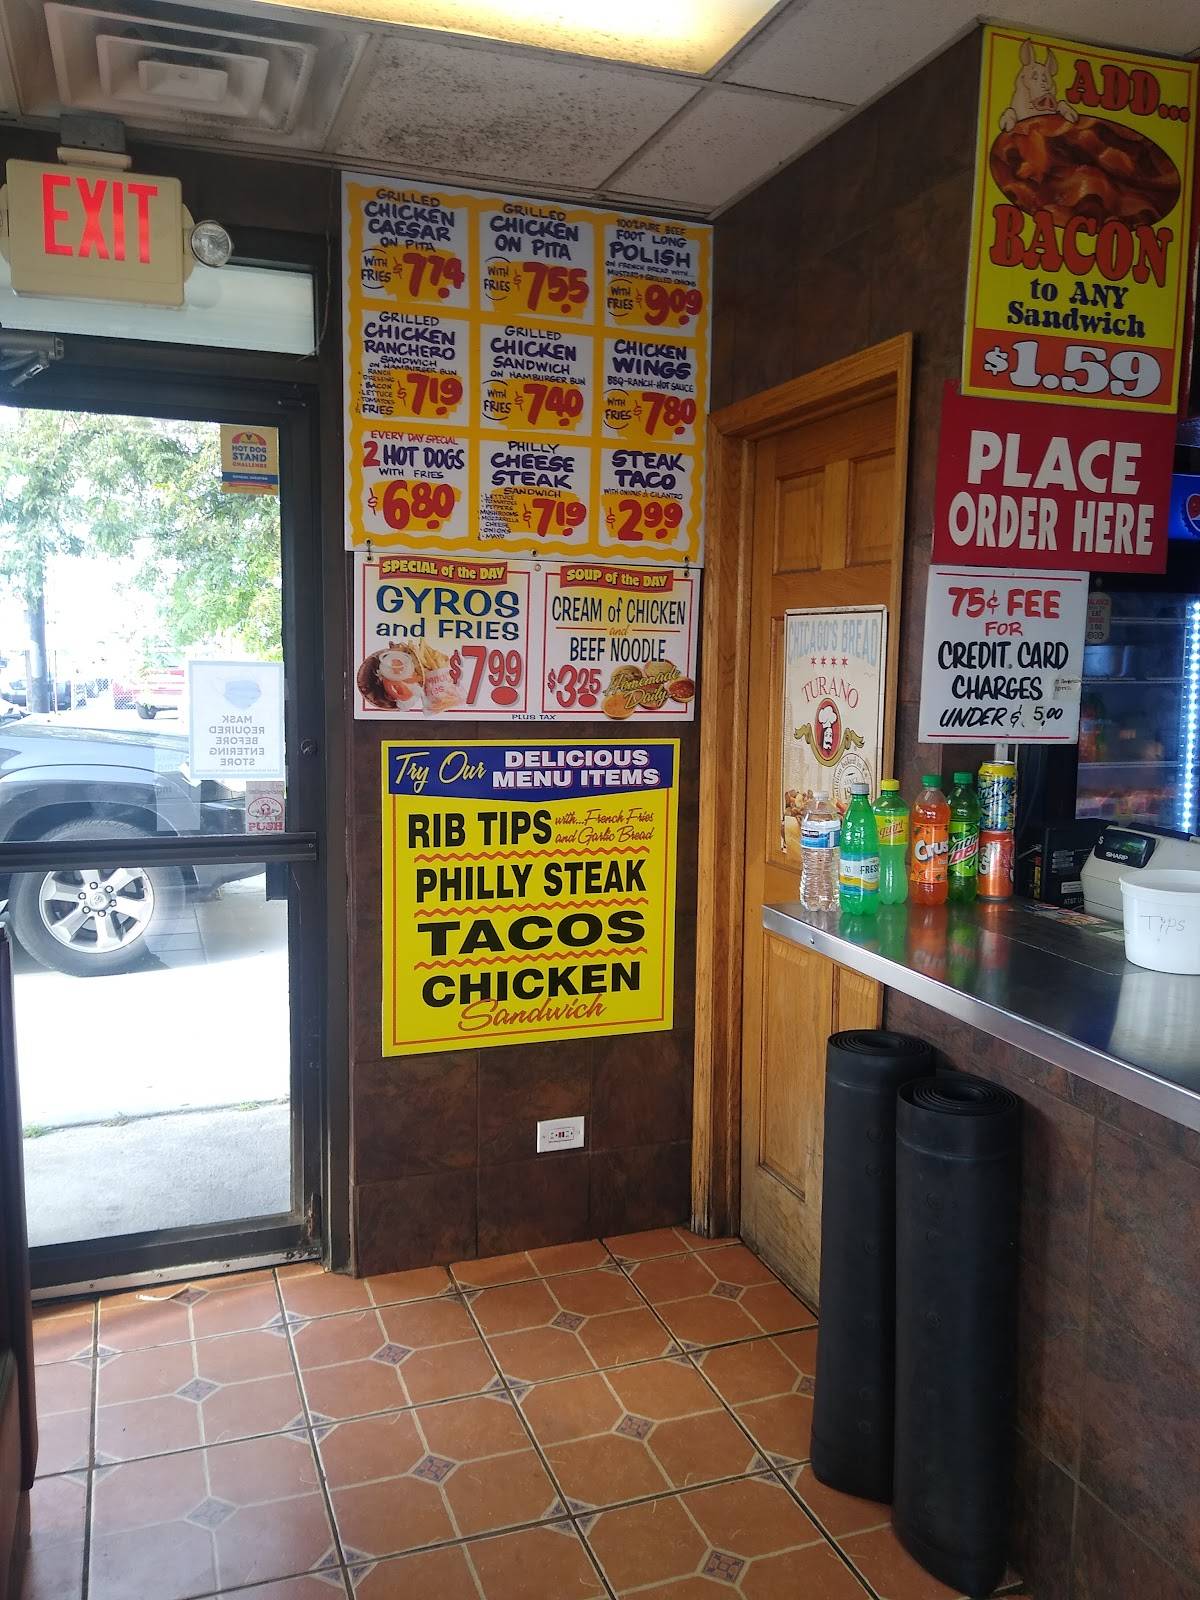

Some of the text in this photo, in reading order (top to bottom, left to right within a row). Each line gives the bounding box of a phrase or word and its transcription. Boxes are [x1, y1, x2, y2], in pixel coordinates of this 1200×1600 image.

[376, 189, 440, 207] GRILLED
[43, 173, 158, 264] EXIT
[365, 201, 454, 227] CHICKEN
[503, 204, 566, 221] GRILLED
[368, 219, 451, 241] CAESAR
[490, 216, 578, 241] CHICKEN
[616, 230, 687, 248] FOOT LONG
[380, 237, 436, 252] ON PITA
[495, 235, 571, 260] ON PITA
[609, 241, 690, 268] POLISH
[990, 204, 1173, 287] BACON
[364, 256, 388, 267] WITH
[488, 266, 509, 277] WITH
[362, 269, 391, 282] FRIES
[484, 279, 510, 292] FRIES
[607, 298, 633, 310] FRIES
[1031, 278, 1128, 309] to ANY
[379, 311, 440, 326] GRILLED
[1008, 301, 1145, 337] Sandwich
[364, 322, 455, 346] CHICKEN
[505, 325, 561, 341] GRILLED
[364, 340, 455, 361] RANCHERO
[490, 338, 576, 362] CHICKEN
[614, 339, 687, 361] CHICKEN
[380, 356, 437, 367] SANDWICH
[493, 356, 570, 375] SANDWICH
[612, 357, 691, 380] WINGS
[984, 340, 1161, 397] $1.59
[362, 404, 394, 415] FRIES
[484, 400, 511, 414] FRIES
[605, 409, 632, 420] FRIES
[371, 430, 458, 445] EVERY DAY SPECIAL
[508, 441, 560, 454] PHILLY
[232, 452, 267, 462] STAND
[363, 441, 465, 470] 2 HOT DOGS
[490, 453, 575, 473] CHEESE
[612, 450, 685, 472] STEAK
[967, 429, 1142, 495] PLACE
[379, 468, 444, 479] WITH FRIES
[491, 470, 572, 490] STEAK
[615, 470, 676, 490] TACO
[504, 487, 560, 498] SANDWICH
[948, 491, 1155, 556] ORDER HERE
[382, 560, 505, 580] SPECIAL of the DAY
[567, 569, 667, 587] SOUP of the DAY
[376, 585, 520, 618] GYROS
[552, 596, 686, 625] CREAM of CHICKEN
[948, 587, 1000, 618] 75¢
[1007, 588, 1061, 619] FEE
[376, 618, 519, 641] and FRIES
[609, 625, 630, 636] and
[985, 621, 1023, 637] FOR
[570, 637, 666, 662] BEEF NOODLE
[842, 618, 878, 667] BREAD
[937, 640, 1069, 670] CREDIT CARD
[603, 666, 681, 696] Homemade
[951, 674, 1043, 701] CHARGES
[802, 676, 859, 708] TURANO
[939, 706, 1007, 727] UNDER
[505, 750, 649, 768] DELICIOUS
[395, 750, 486, 793] Try Our
[492, 769, 661, 789] MENU ITEMS
[626, 807, 654, 824] Fries
[408, 810, 553, 849] RIB TIPS
[555, 825, 655, 845] and Garlic Bread
[914, 839, 948, 861] Crus
[1105, 851, 1128, 860] SHARP
[416, 860, 647, 903] PHILLY STEAK
[417, 910, 645, 957] TACOS
[422, 962, 641, 1008] CHICKEN
[457, 994, 608, 1032] Sandwich
